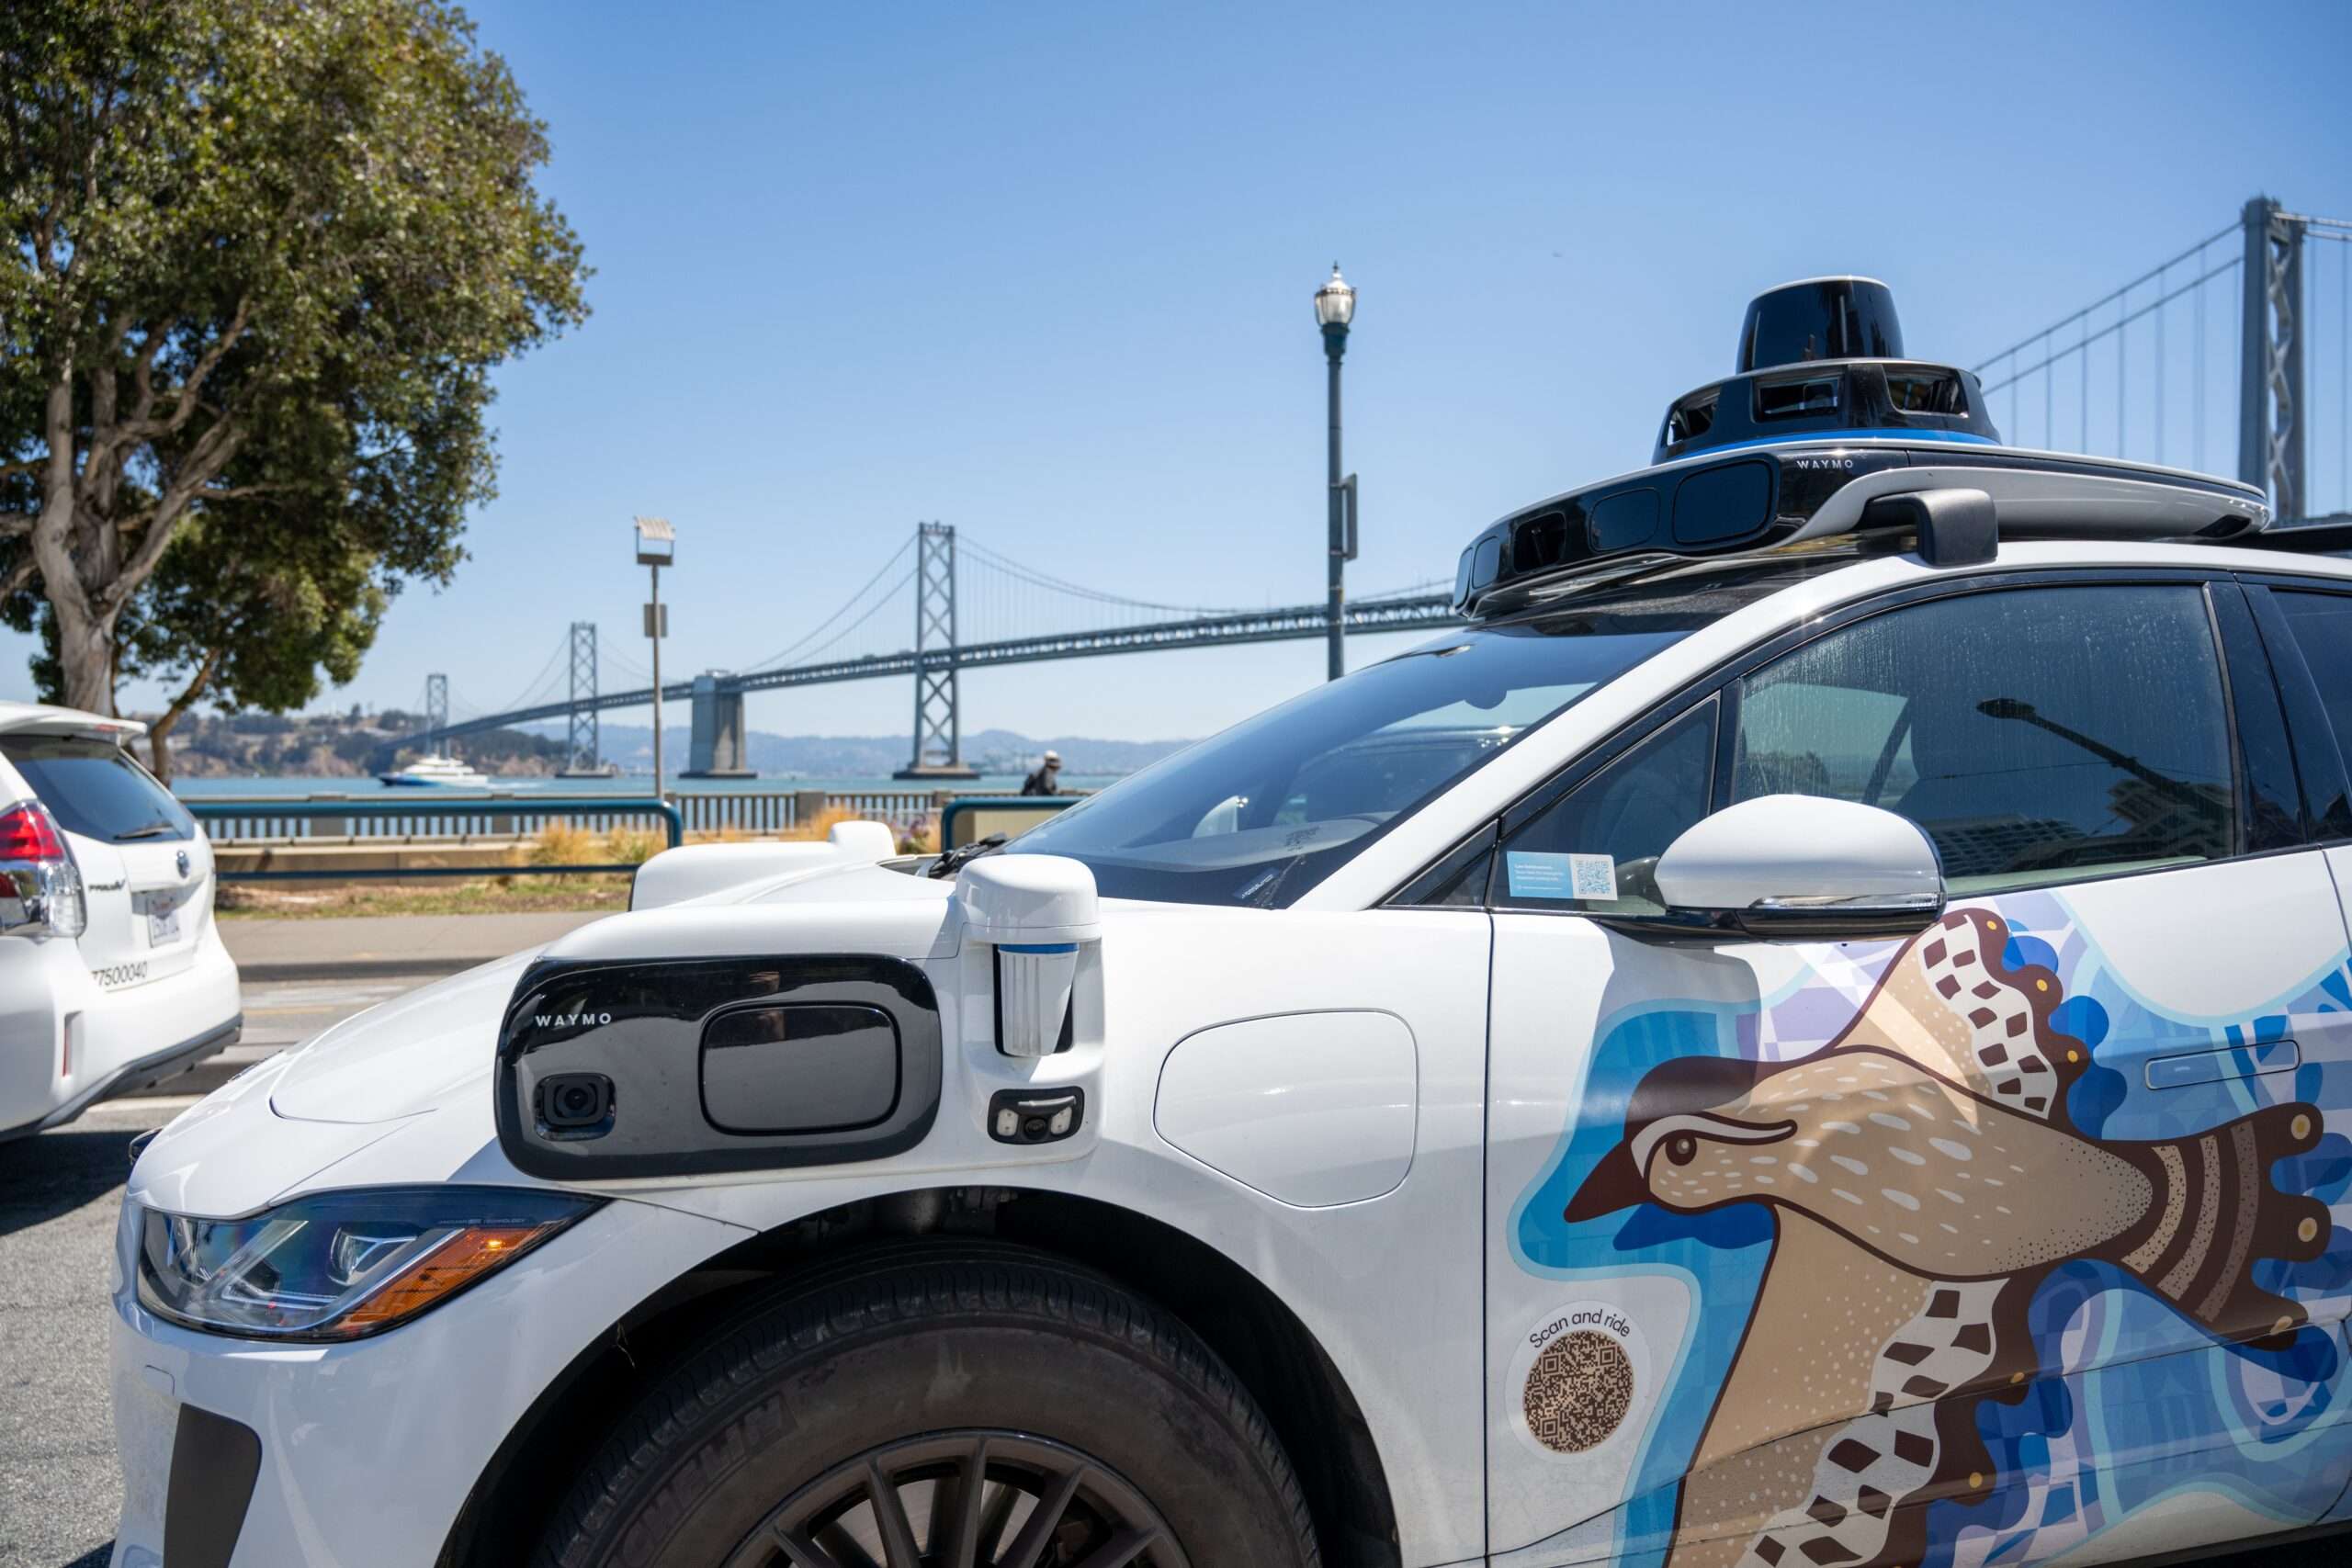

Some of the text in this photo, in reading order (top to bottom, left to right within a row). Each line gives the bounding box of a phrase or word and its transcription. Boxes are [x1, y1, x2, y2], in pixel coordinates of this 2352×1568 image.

[1796, 459, 1853, 469] WAYMO
[536, 1012, 612, 1027] WAYMO
[1529, 1308, 1631, 1348] Scan and ride
[606, 1392, 783, 1568] CHELIN
